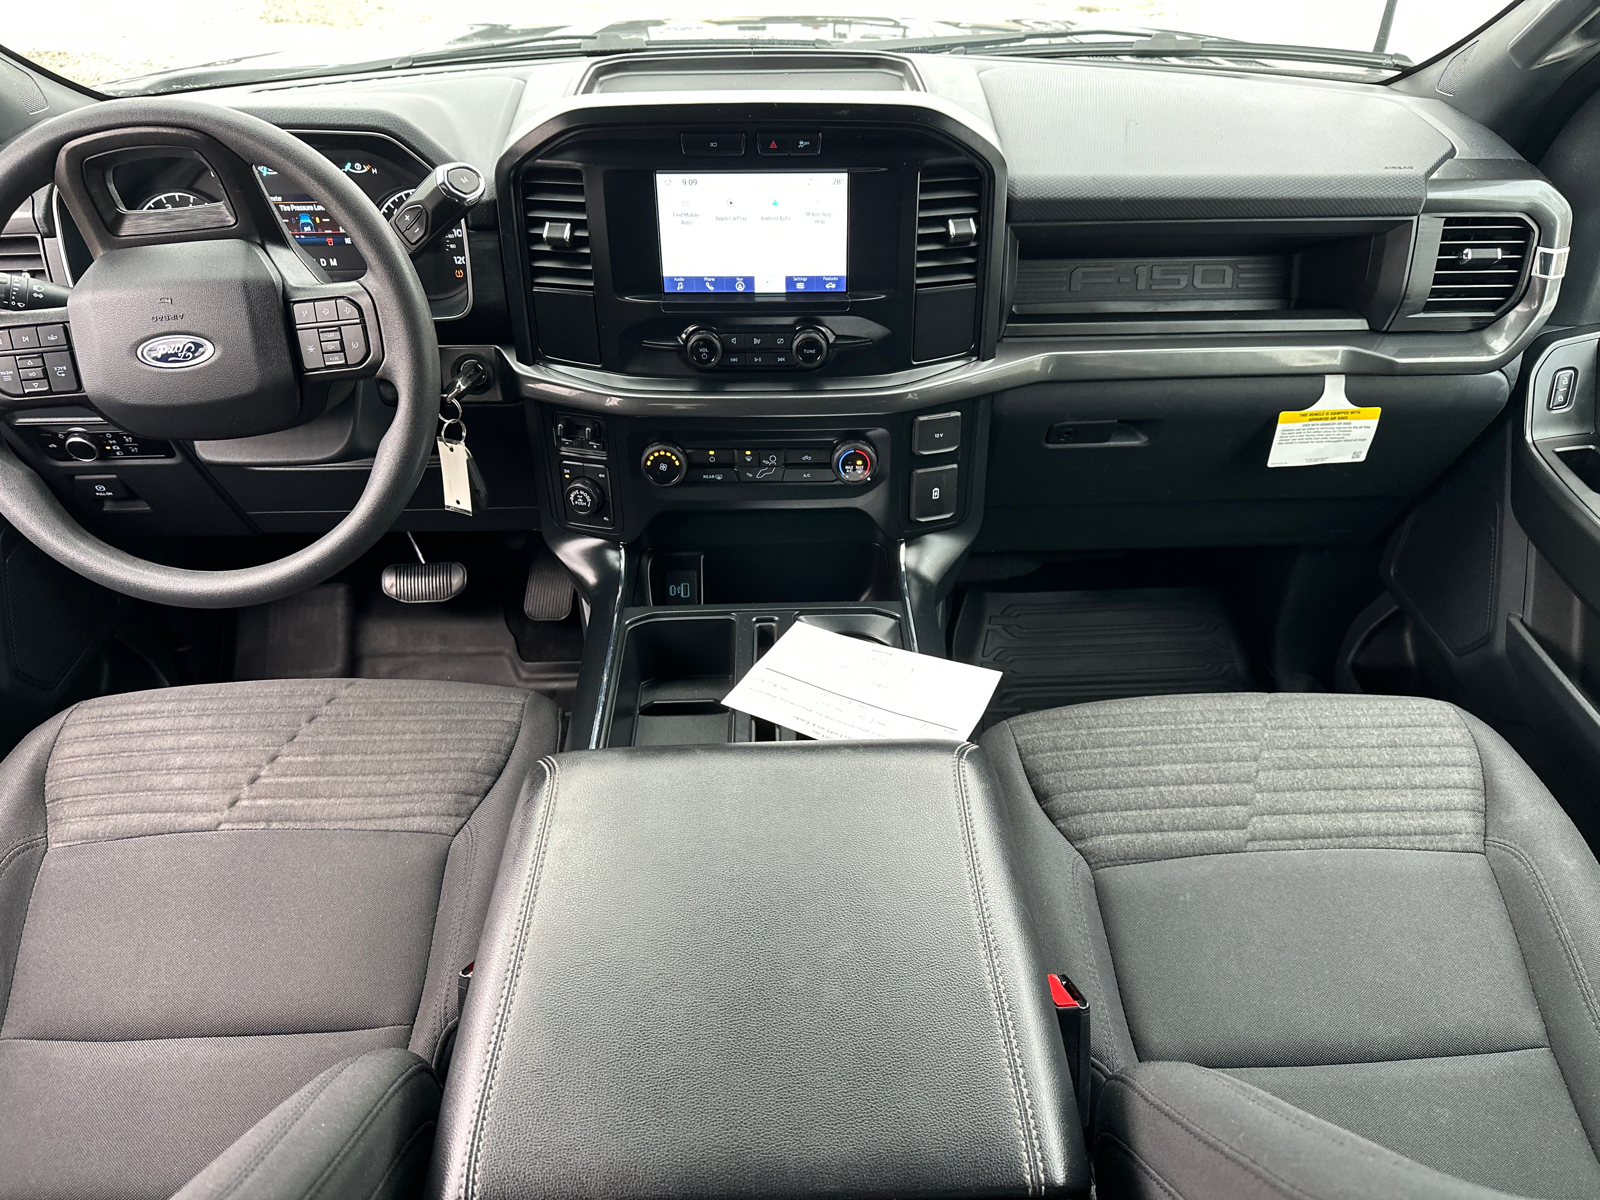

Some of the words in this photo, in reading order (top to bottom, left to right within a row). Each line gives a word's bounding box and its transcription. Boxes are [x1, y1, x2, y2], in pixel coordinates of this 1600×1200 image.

[460, 176, 469, 184] M
[278, 204, 291, 212] Tire
[320, 258, 327, 267] D
[329, 258, 338, 267] M
[1069, 264, 1234, 292] F-150
